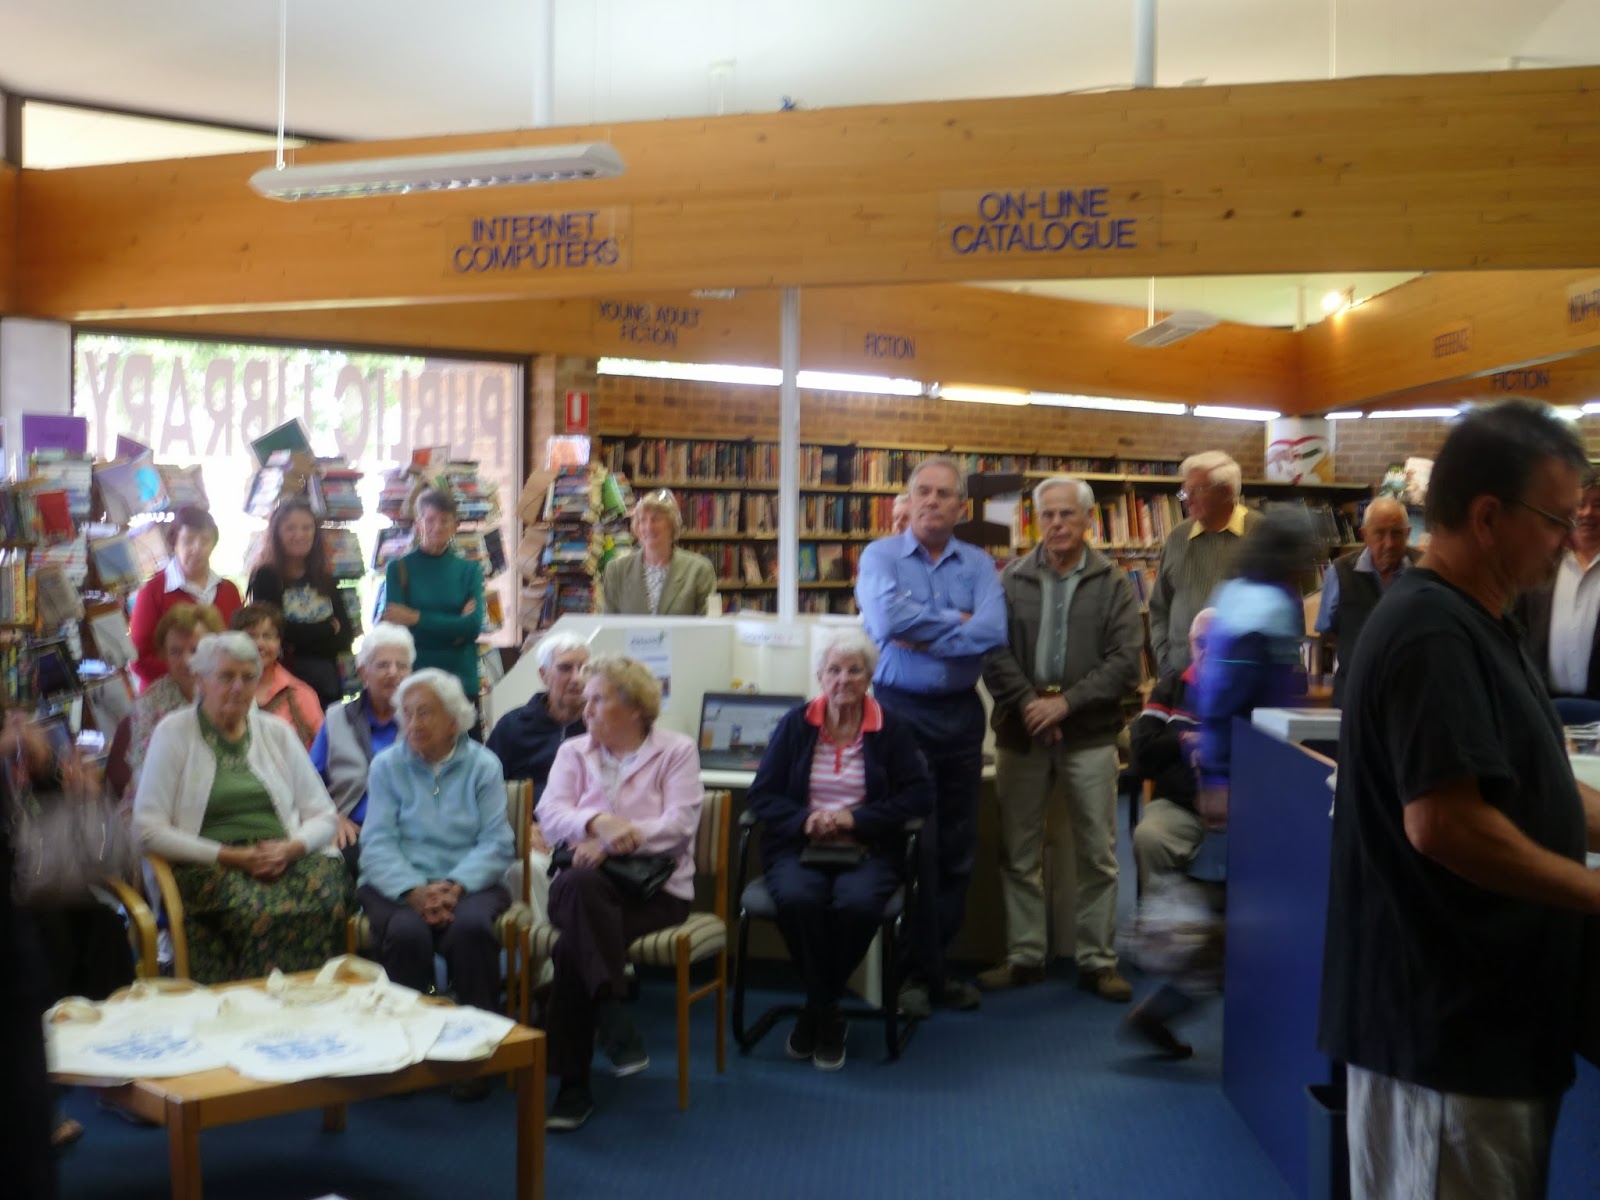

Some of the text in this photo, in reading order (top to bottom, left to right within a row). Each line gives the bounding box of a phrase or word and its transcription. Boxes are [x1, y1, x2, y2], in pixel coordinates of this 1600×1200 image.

[979, 188, 1110, 222] ON-LINE
[472, 211, 596, 242] INTERNET
[952, 219, 1138, 254] CATALOGUE
[454, 239, 619, 273] COMPUTERS
[864, 331, 916, 359] FICTION
[1491, 368, 1551, 392] FICTION
